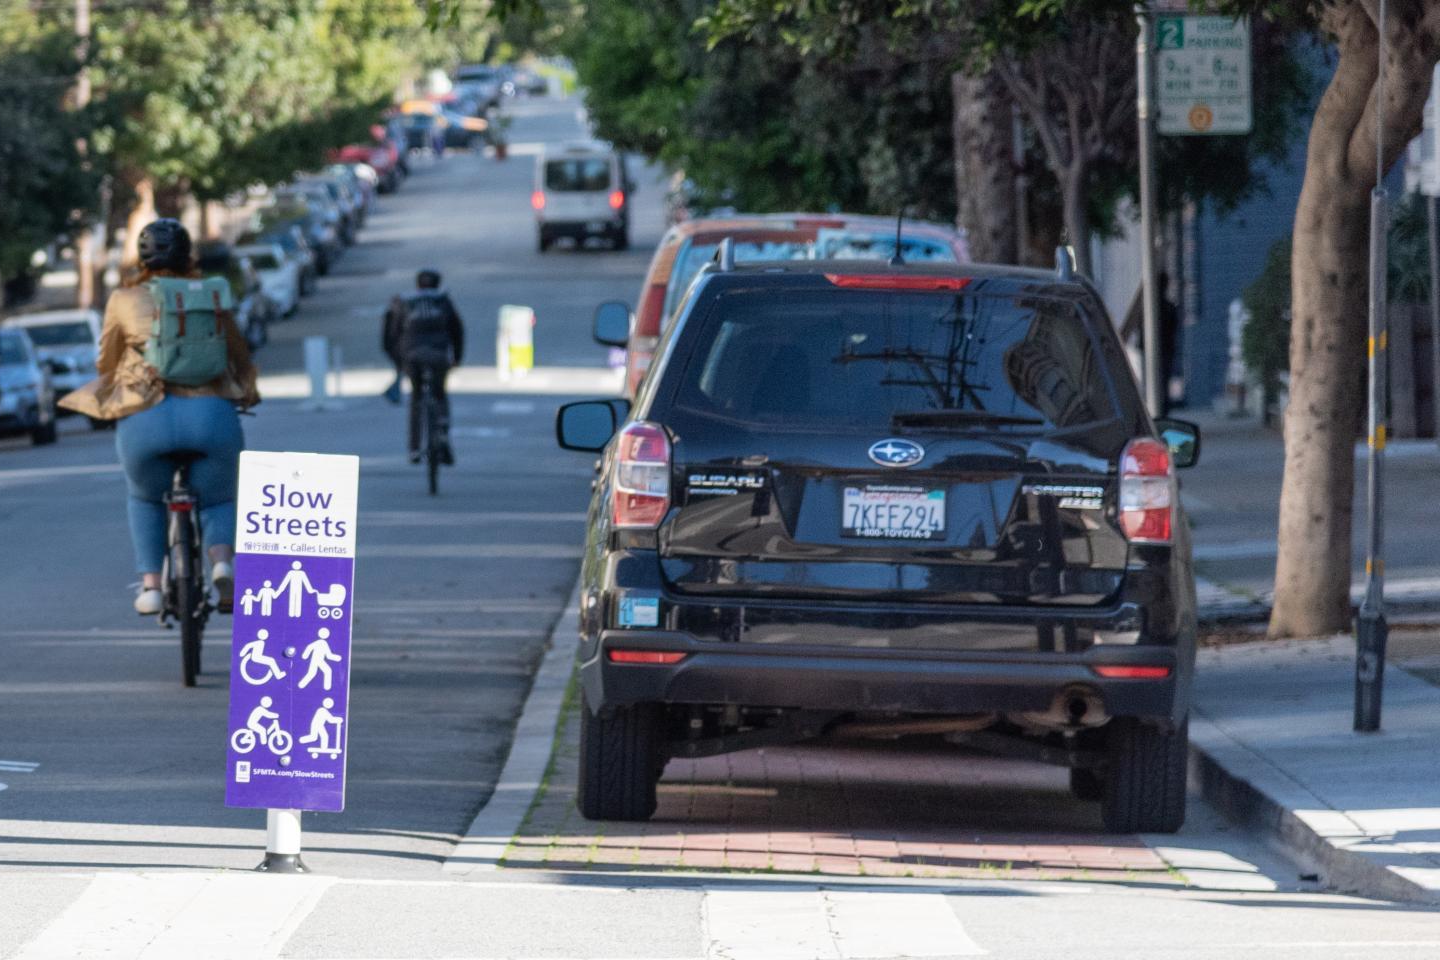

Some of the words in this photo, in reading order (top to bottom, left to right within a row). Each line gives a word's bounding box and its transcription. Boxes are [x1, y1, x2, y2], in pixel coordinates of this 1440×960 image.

[1162, 22, 1178, 48] 2
[1188, 38, 1243, 48] PARKING
[689, 474, 764, 488] SUBARU
[262, 483, 333, 509] Slow
[1022, 485, 1104, 497] FORESTER
[246, 511, 347, 538] Streets
[290, 543, 316, 552] Calles
[318, 544, 347, 554] Lentas
[253, 768, 334, 779] SFMTA.com/SlowStreets
